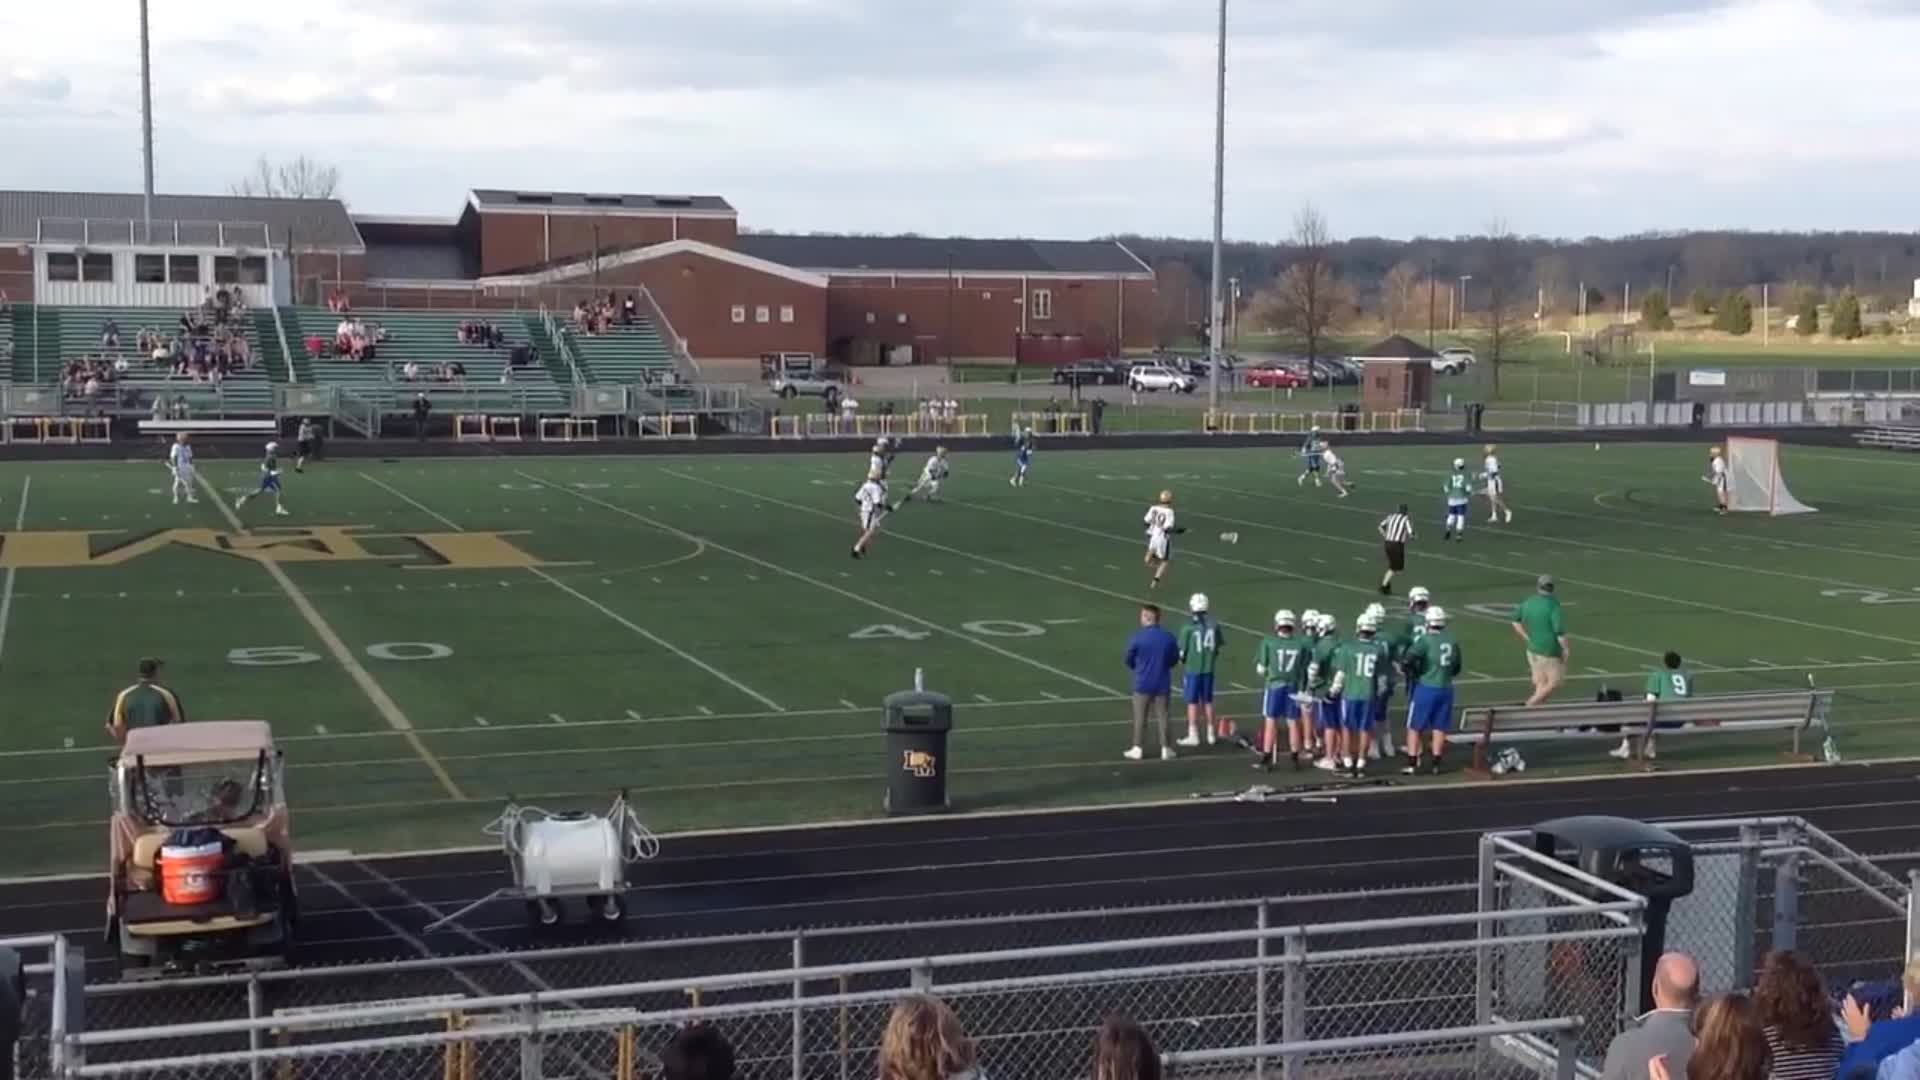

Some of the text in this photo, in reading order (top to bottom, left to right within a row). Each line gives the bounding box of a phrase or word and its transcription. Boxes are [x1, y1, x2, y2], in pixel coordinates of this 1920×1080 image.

[1193, 628, 1215, 653] 14
[1277, 649, 1298, 672] 17
[1355, 653, 1376, 678] 16
[1440, 642, 1452, 666] 2
[1671, 673, 1686, 695] 9
